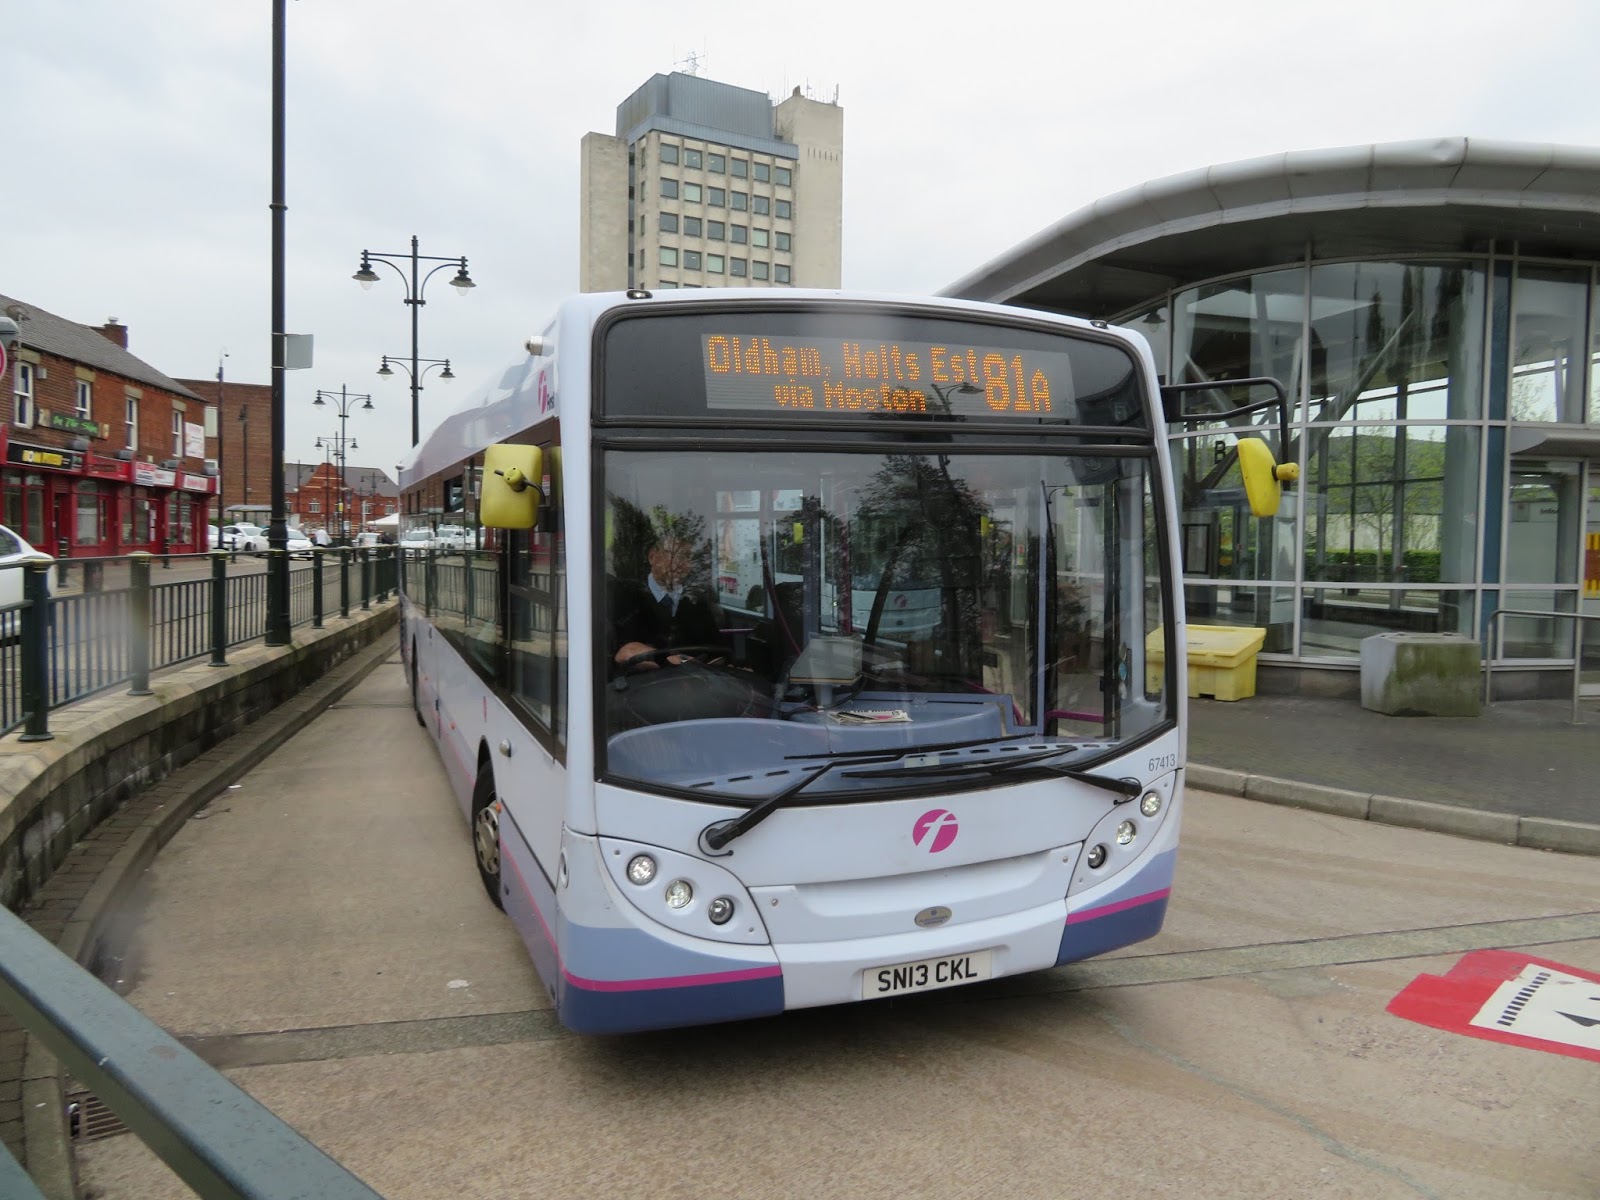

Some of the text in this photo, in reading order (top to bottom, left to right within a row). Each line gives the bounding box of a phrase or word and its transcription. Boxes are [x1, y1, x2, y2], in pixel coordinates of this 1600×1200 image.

[708, 336, 979, 383] Oldham, Holts Est
[774, 378, 927, 411] via Moston
[983, 353, 1052, 412] 81A
[1214, 440, 1226, 464] B
[1148, 753, 1176, 771] 67413
[877, 957, 978, 992] SN13 CKL
